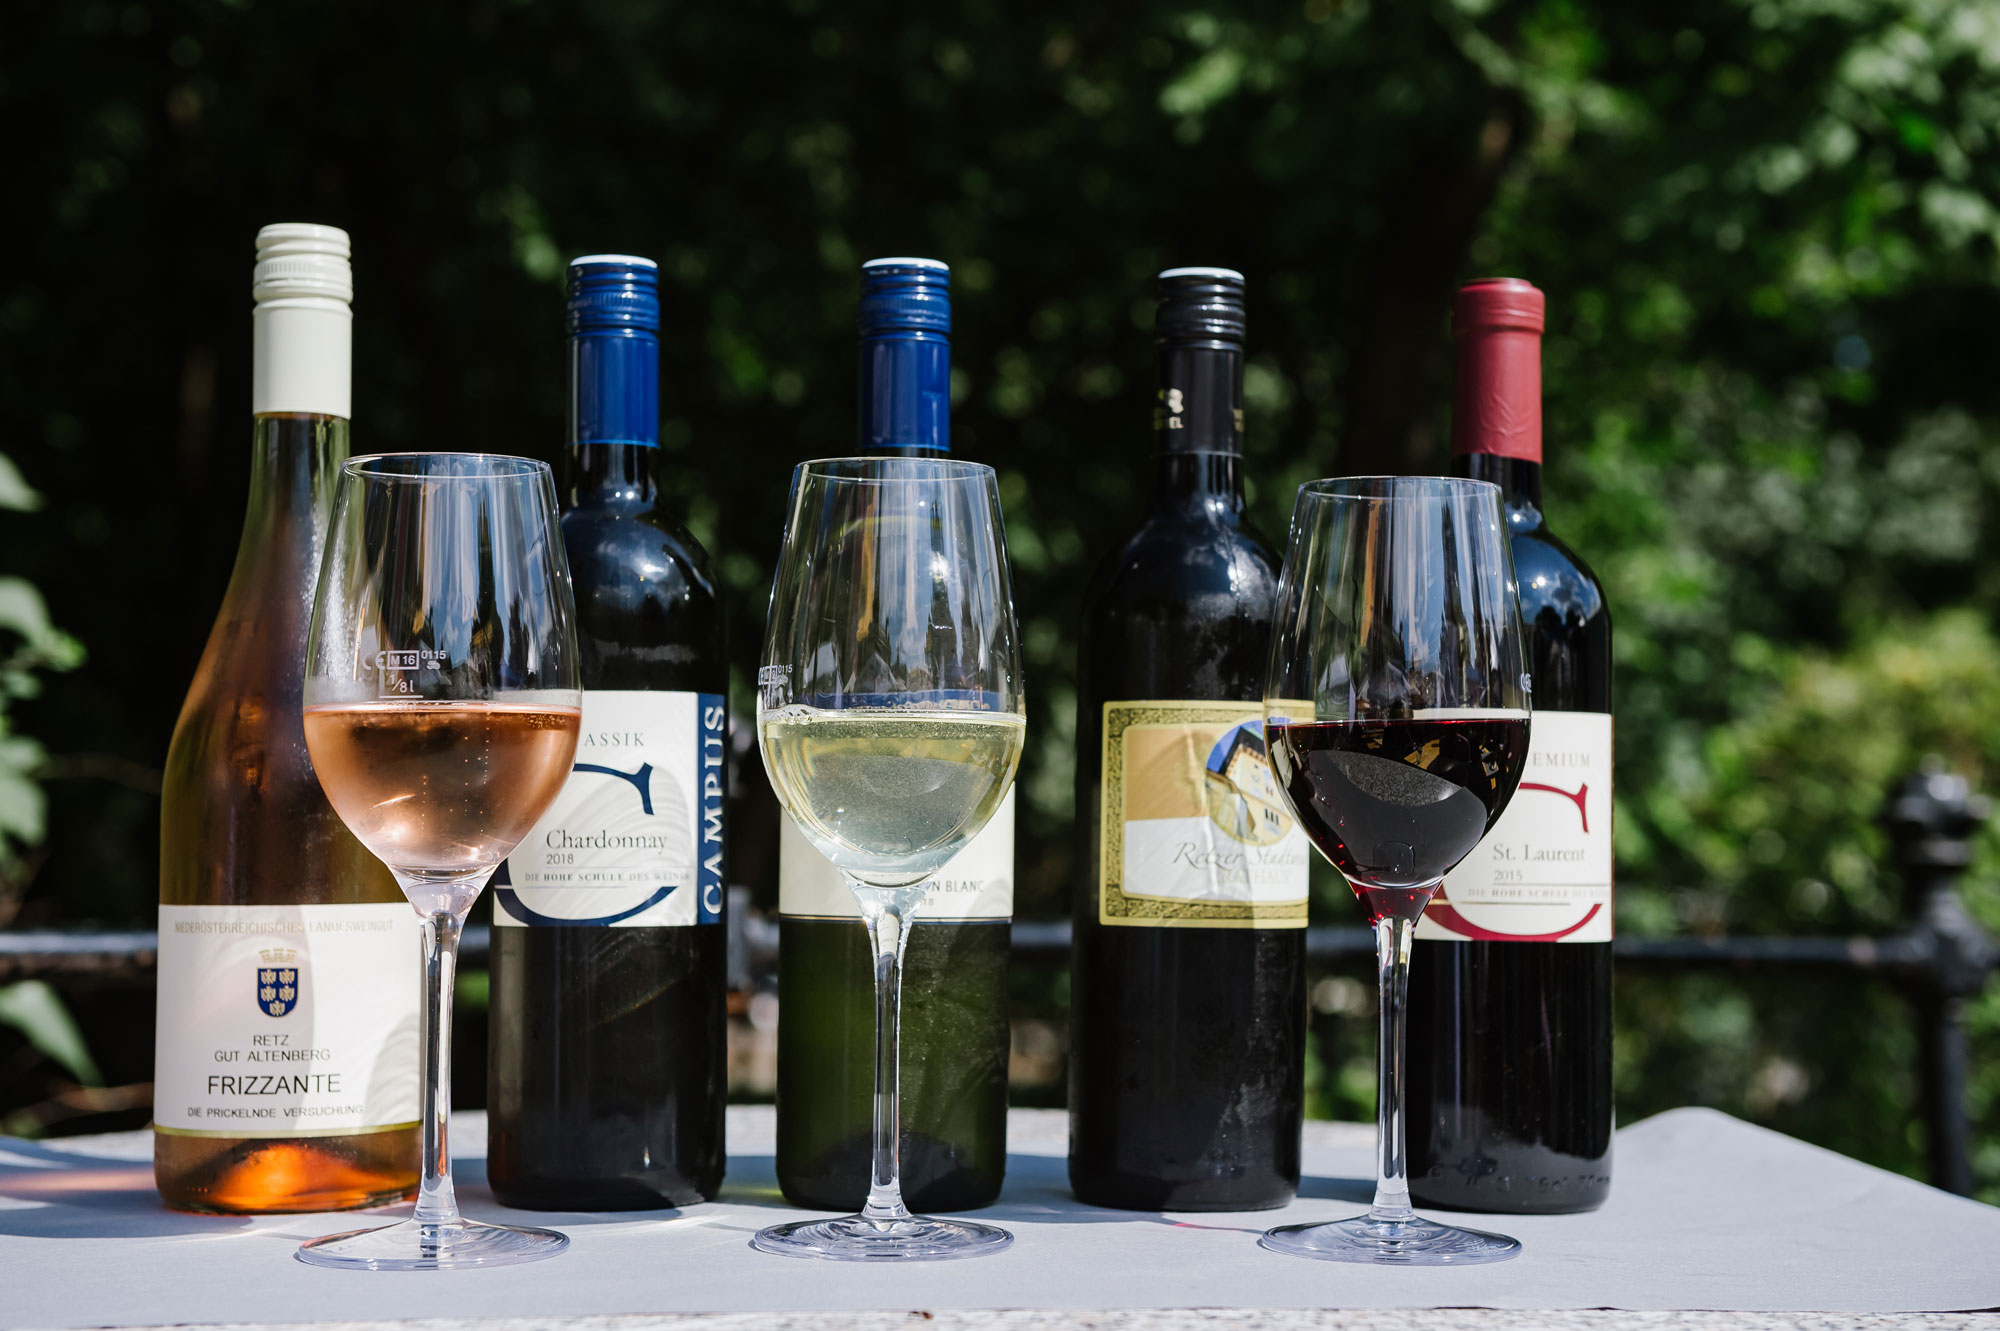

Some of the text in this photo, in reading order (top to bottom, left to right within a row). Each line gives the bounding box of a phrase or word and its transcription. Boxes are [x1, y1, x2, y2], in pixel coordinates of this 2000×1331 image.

[402, 655, 416, 665] 16
[421, 651, 446, 660] 0115
[584, 732, 645, 747] ASSIK
[1533, 753, 1591, 768] EMIUM
[703, 706, 724, 915] CAMPUS
[546, 829, 668, 855] Chardonnay
[1493, 843, 1585, 861] St. Laurent
[546, 854, 575, 865] 2018
[525, 872, 539, 882] DIE
[544, 872, 573, 882] HOHE
[578, 872, 623, 882] SCHULE
[629, 871, 649, 881] DES
[1494, 870, 1523, 881] 2015
[945, 881, 984, 892] BLANC
[253, 1034, 289, 1047] RETZ
[214, 1049, 331, 1063] GUT ALTENBERG
[207, 1073, 342, 1095] FRIZZANTE
[188, 1104, 363, 1119] DIE PRICKELNDE VERSUCHUNG
